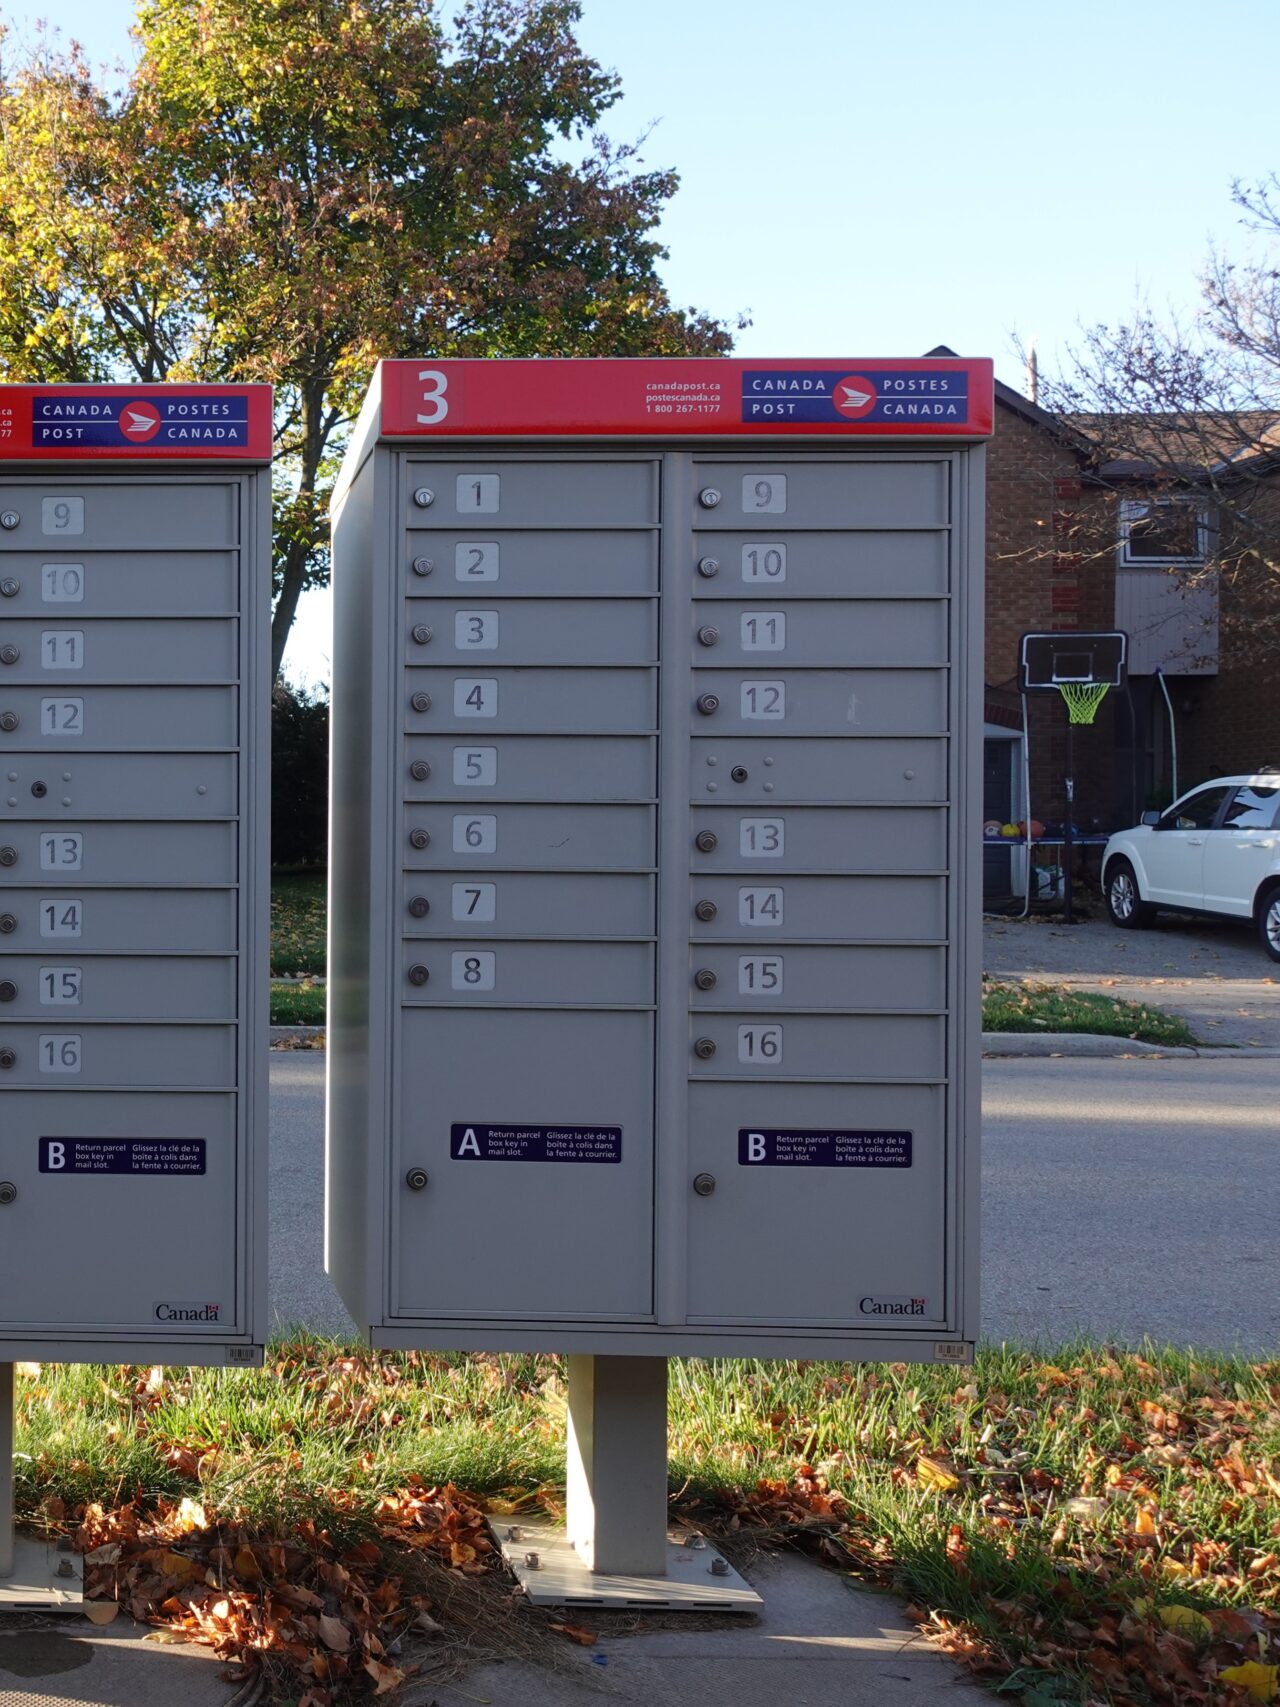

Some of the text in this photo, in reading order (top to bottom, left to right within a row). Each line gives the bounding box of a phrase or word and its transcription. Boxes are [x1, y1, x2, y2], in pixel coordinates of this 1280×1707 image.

[416, 370, 449, 424] 3
[646, 382, 721, 391] canadapost.ca
[646, 394, 720, 403] postescanada.ca
[752, 380, 826, 391] CANADA
[883, 380, 949, 391] POSTES
[42, 405, 113, 416] CANADA
[168, 405, 230, 415] POSTES
[655, 405, 672, 413] 800
[676, 405, 720, 413] 267-1177
[752, 404, 795, 415] POST
[883, 404, 957, 415] CANADA
[42, 429, 84, 439] POST
[168, 428, 238, 438] CANADA
[471, 481, 481, 507] 1
[754, 480, 773, 508] 9
[53, 502, 71, 529] 9
[467, 548, 485, 575] 2
[747, 549, 782, 577] 10
[47, 569, 80, 595] 10
[467, 616, 484, 644] 3
[746, 618, 776, 644] 11
[46, 636, 76, 663] 11
[465, 685, 485, 711] 4
[746, 687, 780, 713] 12
[46, 703, 79, 729] 12
[466, 753, 482, 780] 5
[465, 820, 483, 847] 6
[745, 824, 779, 851] 13
[45, 838, 78, 864] 13
[464, 889, 482, 915] 7
[744, 893, 780, 920] 14
[45, 905, 79, 931] 14
[463, 957, 481, 984] 8
[743, 962, 778, 989] 15
[44, 972, 78, 999] 15
[44, 1040, 78, 1067] 16
[743, 1031, 778, 1058] 16
[458, 1128, 481, 1156] A
[748, 1134, 766, 1161] B
[48, 1142, 66, 1169] B
[156, 1304, 218, 1321] Canada
[859, 1298, 925, 1315] Canada
